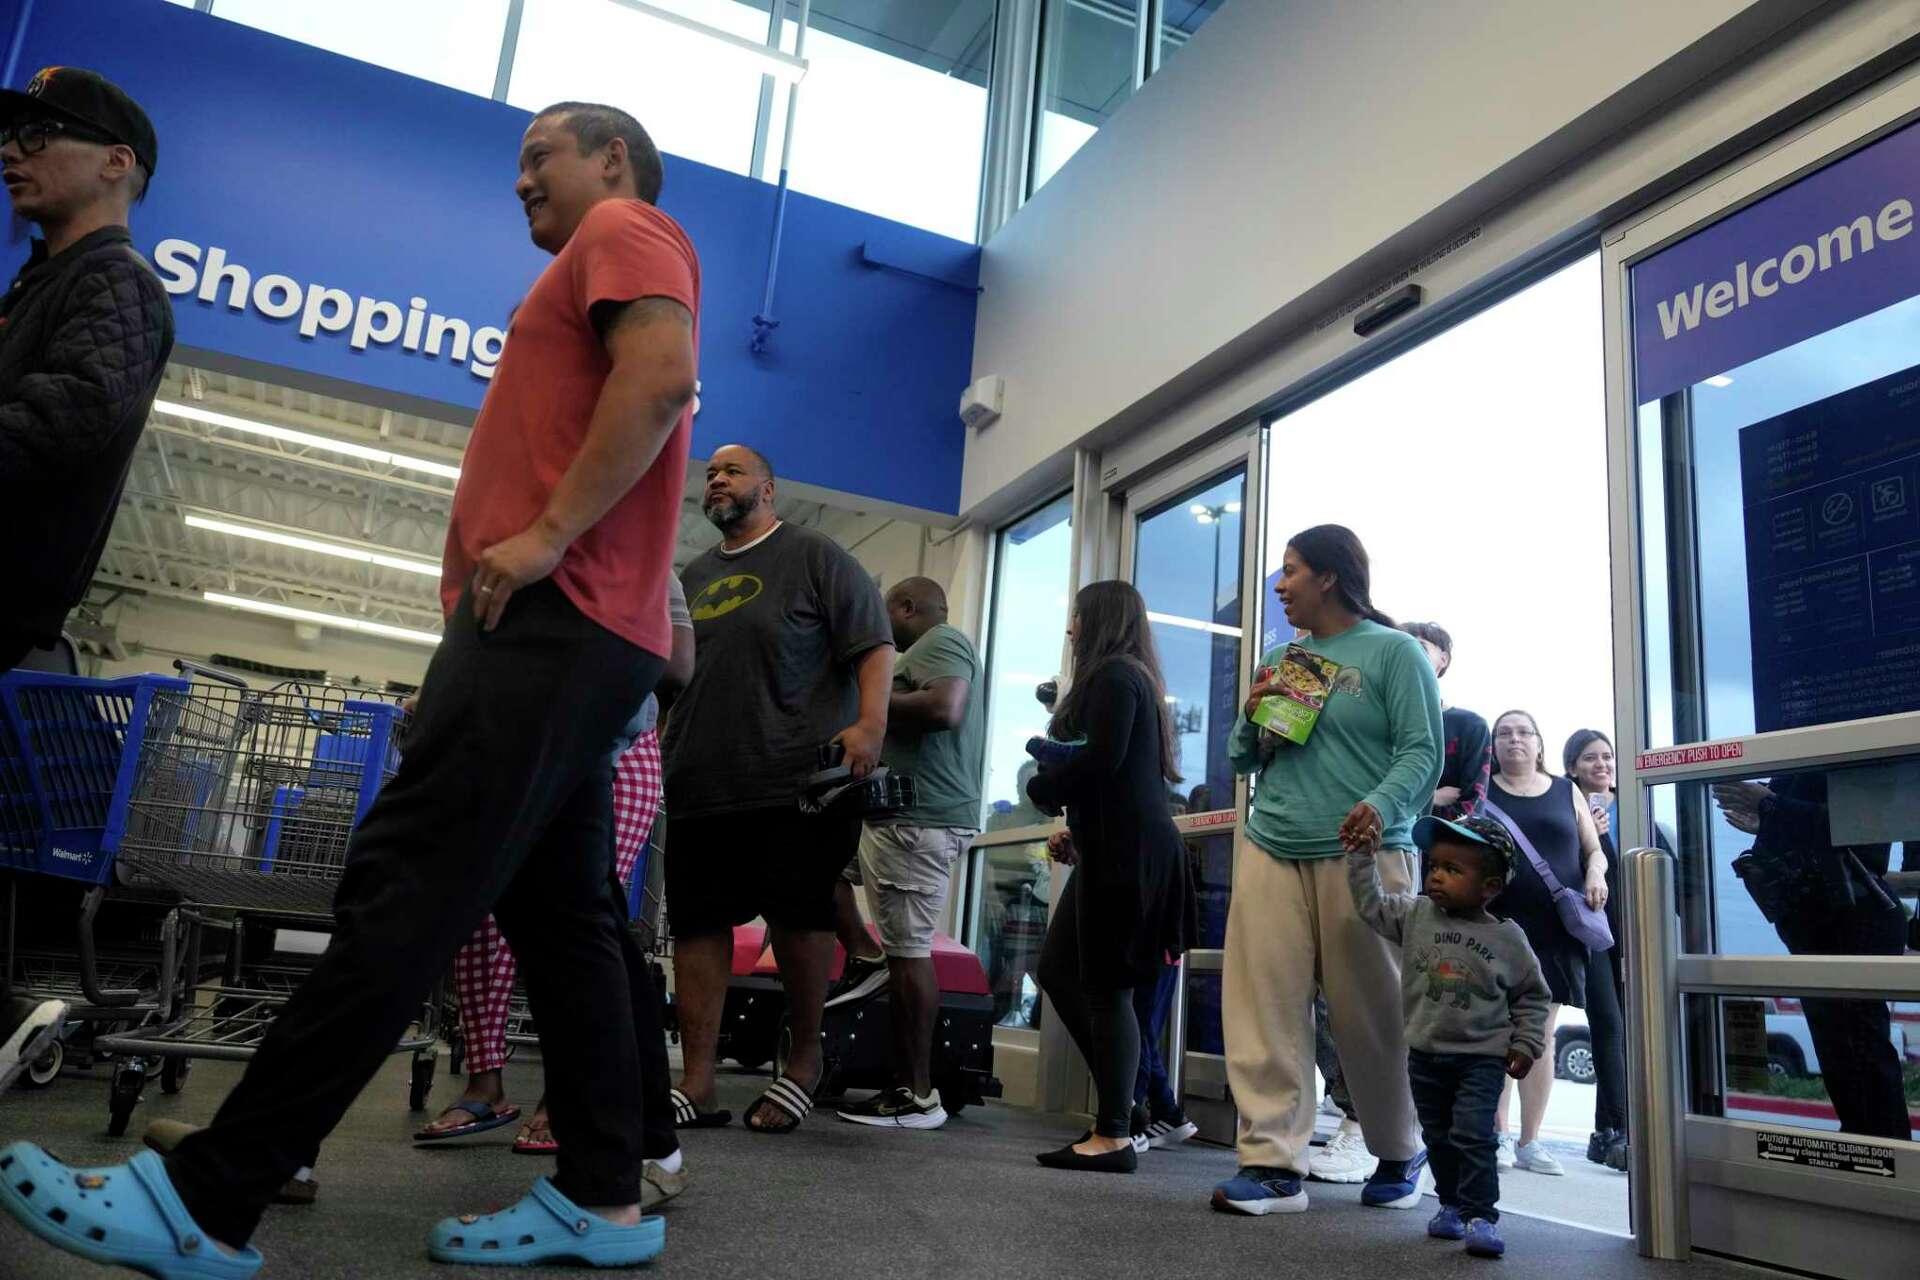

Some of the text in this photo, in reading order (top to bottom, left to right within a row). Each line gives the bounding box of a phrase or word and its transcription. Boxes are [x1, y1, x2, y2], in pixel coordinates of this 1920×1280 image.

[1656, 198, 1914, 340] Welcome
[153, 238, 508, 378] Shopping
[1645, 750, 1686, 768] EMERGENCY
[1688, 747, 1708, 762] PUSH
[1710, 745, 1719, 759] TO
[1721, 742, 1742, 758] OPEN
[53, 848, 82, 861] Walmart
[1434, 932, 1495, 963] DINO PARK
[1768, 1143, 1883, 1168] Door may close without warning
[1793, 1138, 1837, 1151] AUTOMATIC
[1838, 1143, 1869, 1155] SLIDING
[1809, 1159, 1840, 1168] STANLEY
